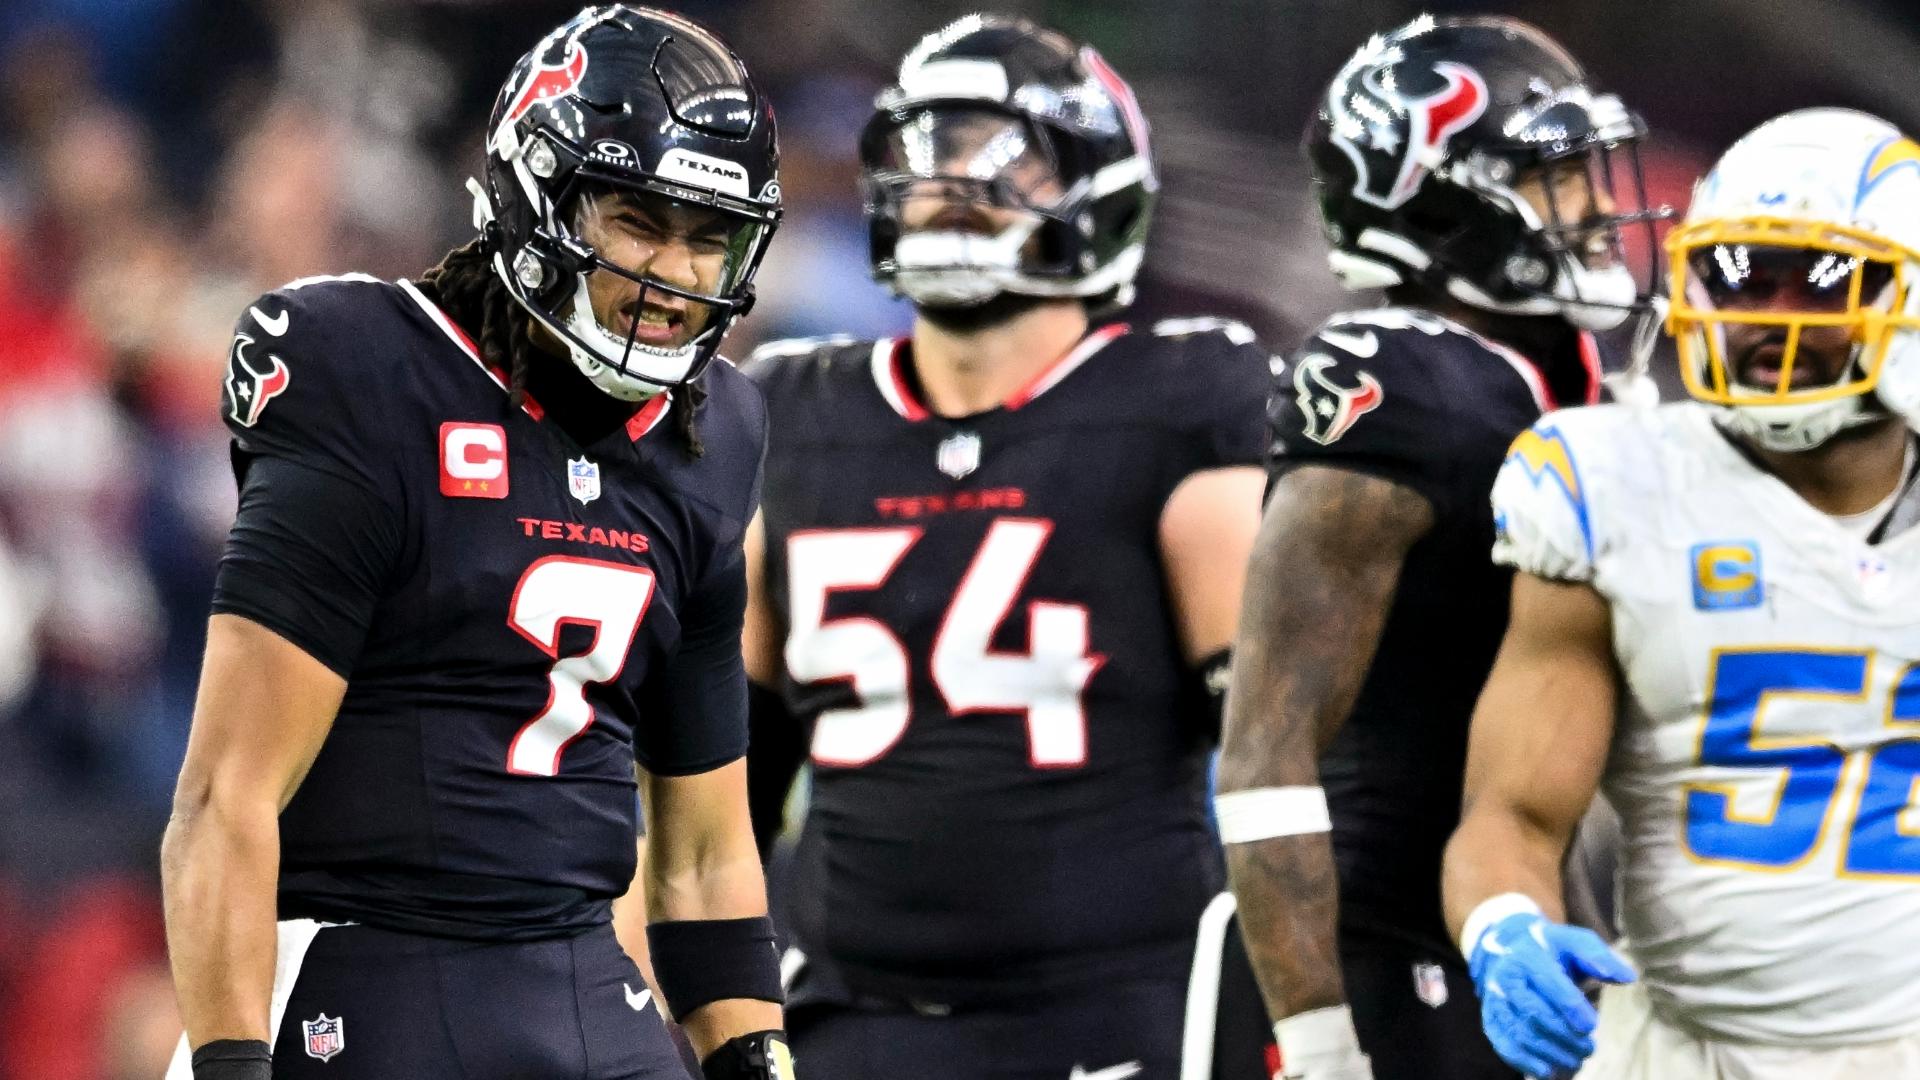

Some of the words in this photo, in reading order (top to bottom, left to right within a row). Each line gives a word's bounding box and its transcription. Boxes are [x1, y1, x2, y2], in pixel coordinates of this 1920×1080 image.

[676, 157, 743, 180] TEXANS
[444, 428, 504, 480] C
[573, 478, 595, 494] NFL
[515, 517, 650, 553] TEXANS
[1696, 546, 1757, 592] C
[783, 516, 1109, 768] 54
[507, 554, 656, 776] 7
[310, 1034, 337, 1053] NFL
